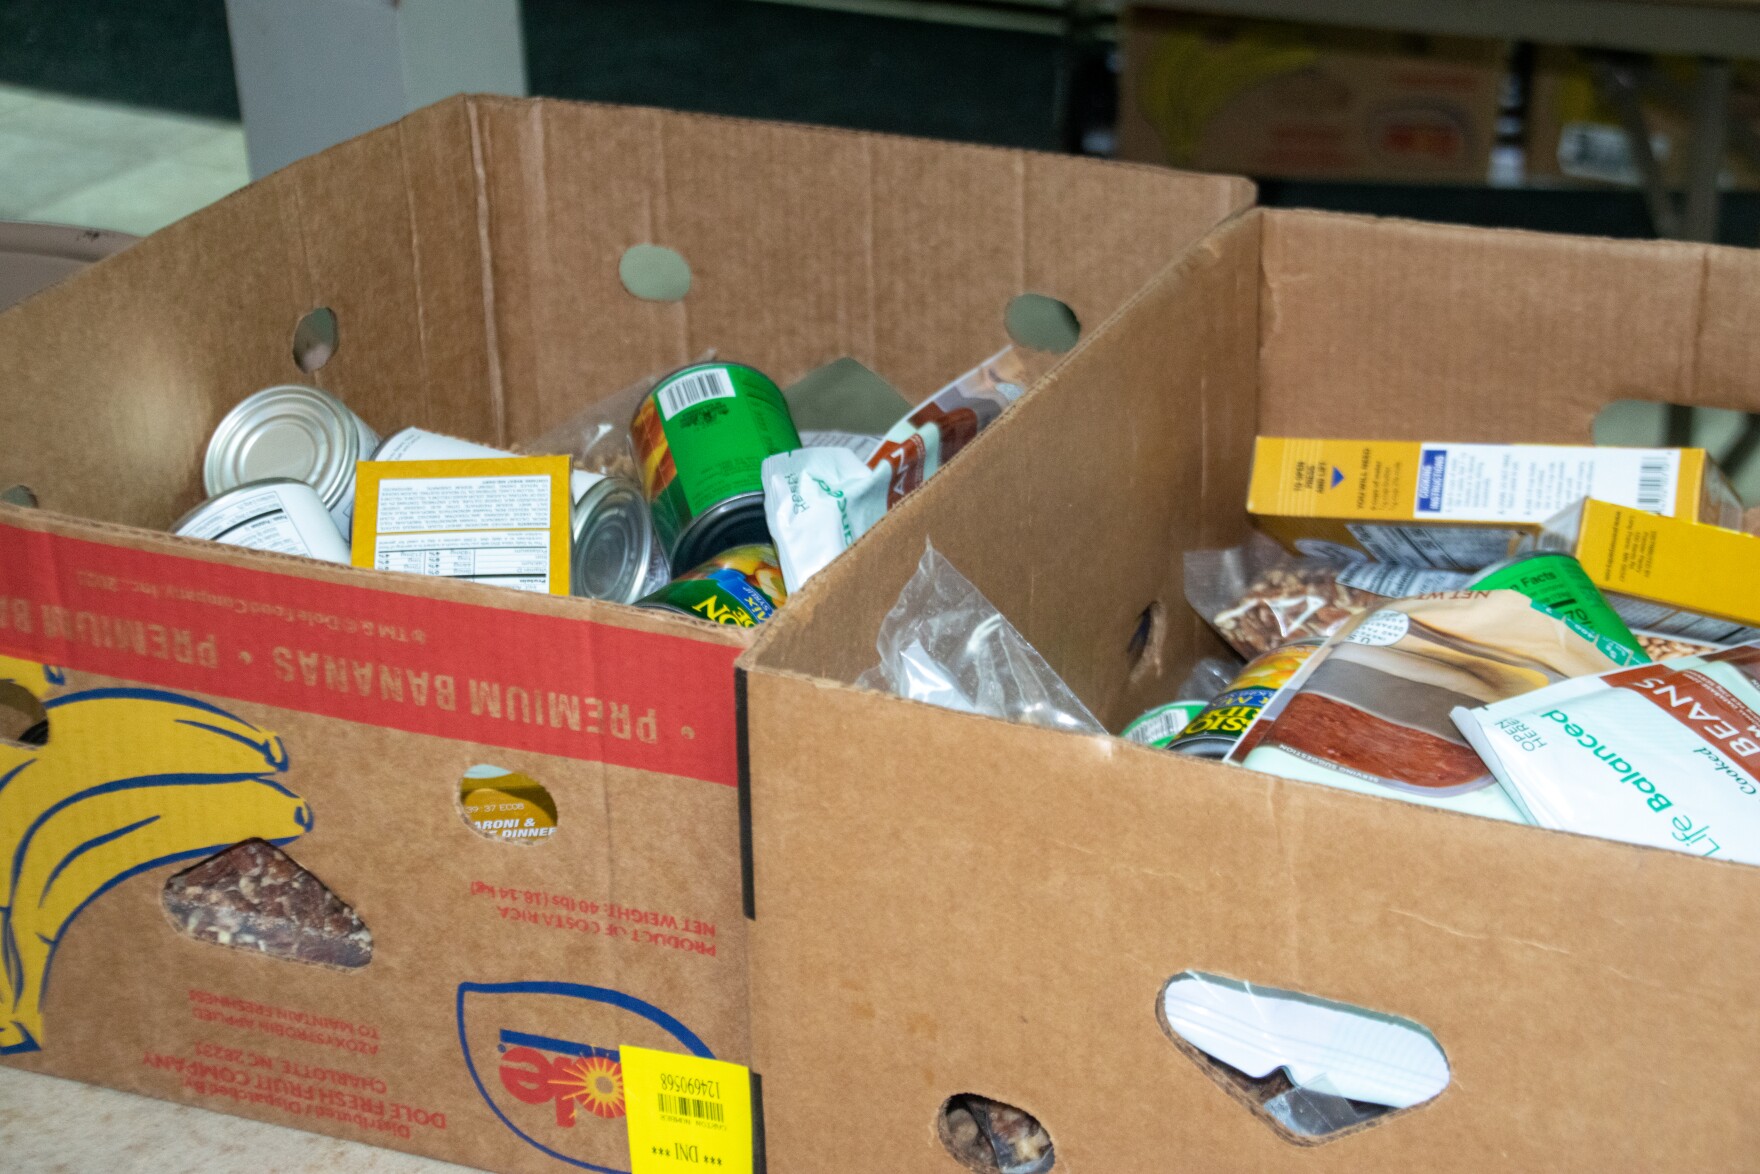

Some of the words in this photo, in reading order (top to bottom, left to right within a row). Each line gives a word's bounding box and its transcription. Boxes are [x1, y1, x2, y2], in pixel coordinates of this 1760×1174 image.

[1449, 590, 1492, 600] NET
[40, 603, 218, 669] PREMIUM
[271, 645, 457, 712] BANANAS
[468, 679, 658, 745] PREMIUM
[1632, 677, 1760, 758] BEANS
[1494, 720, 1536, 753] OPEN
[1510, 717, 1548, 750] HERE
[1278, 743, 1338, 772] SUGGESTION
[1540, 708, 1674, 814] Balanced
[1693, 747, 1757, 796] Cooked
[474, 818, 521, 830] ARONI
[523, 817, 536, 827] &
[1670, 814, 1721, 857] Life
[497, 904, 539, 925] RICA
[552, 895, 577, 912] lbs
[579, 898, 600, 916] 40
[604, 901, 679, 931] WEIGHT:
[542, 911, 601, 937] COSTA
[682, 916, 717, 939] NET
[631, 928, 718, 958] PRODUCT
[357, 1023, 380, 1041] TO
[143, 1051, 251, 1087] COMPANY
[254, 1073, 316, 1101] FRUIT
[499, 1046, 627, 1129] ole
[659, 1072, 721, 1100] 124690568
[318, 1086, 386, 1118] FRESH
[391, 1101, 447, 1130] DOLE
[673, 1142, 699, 1164] DNI
